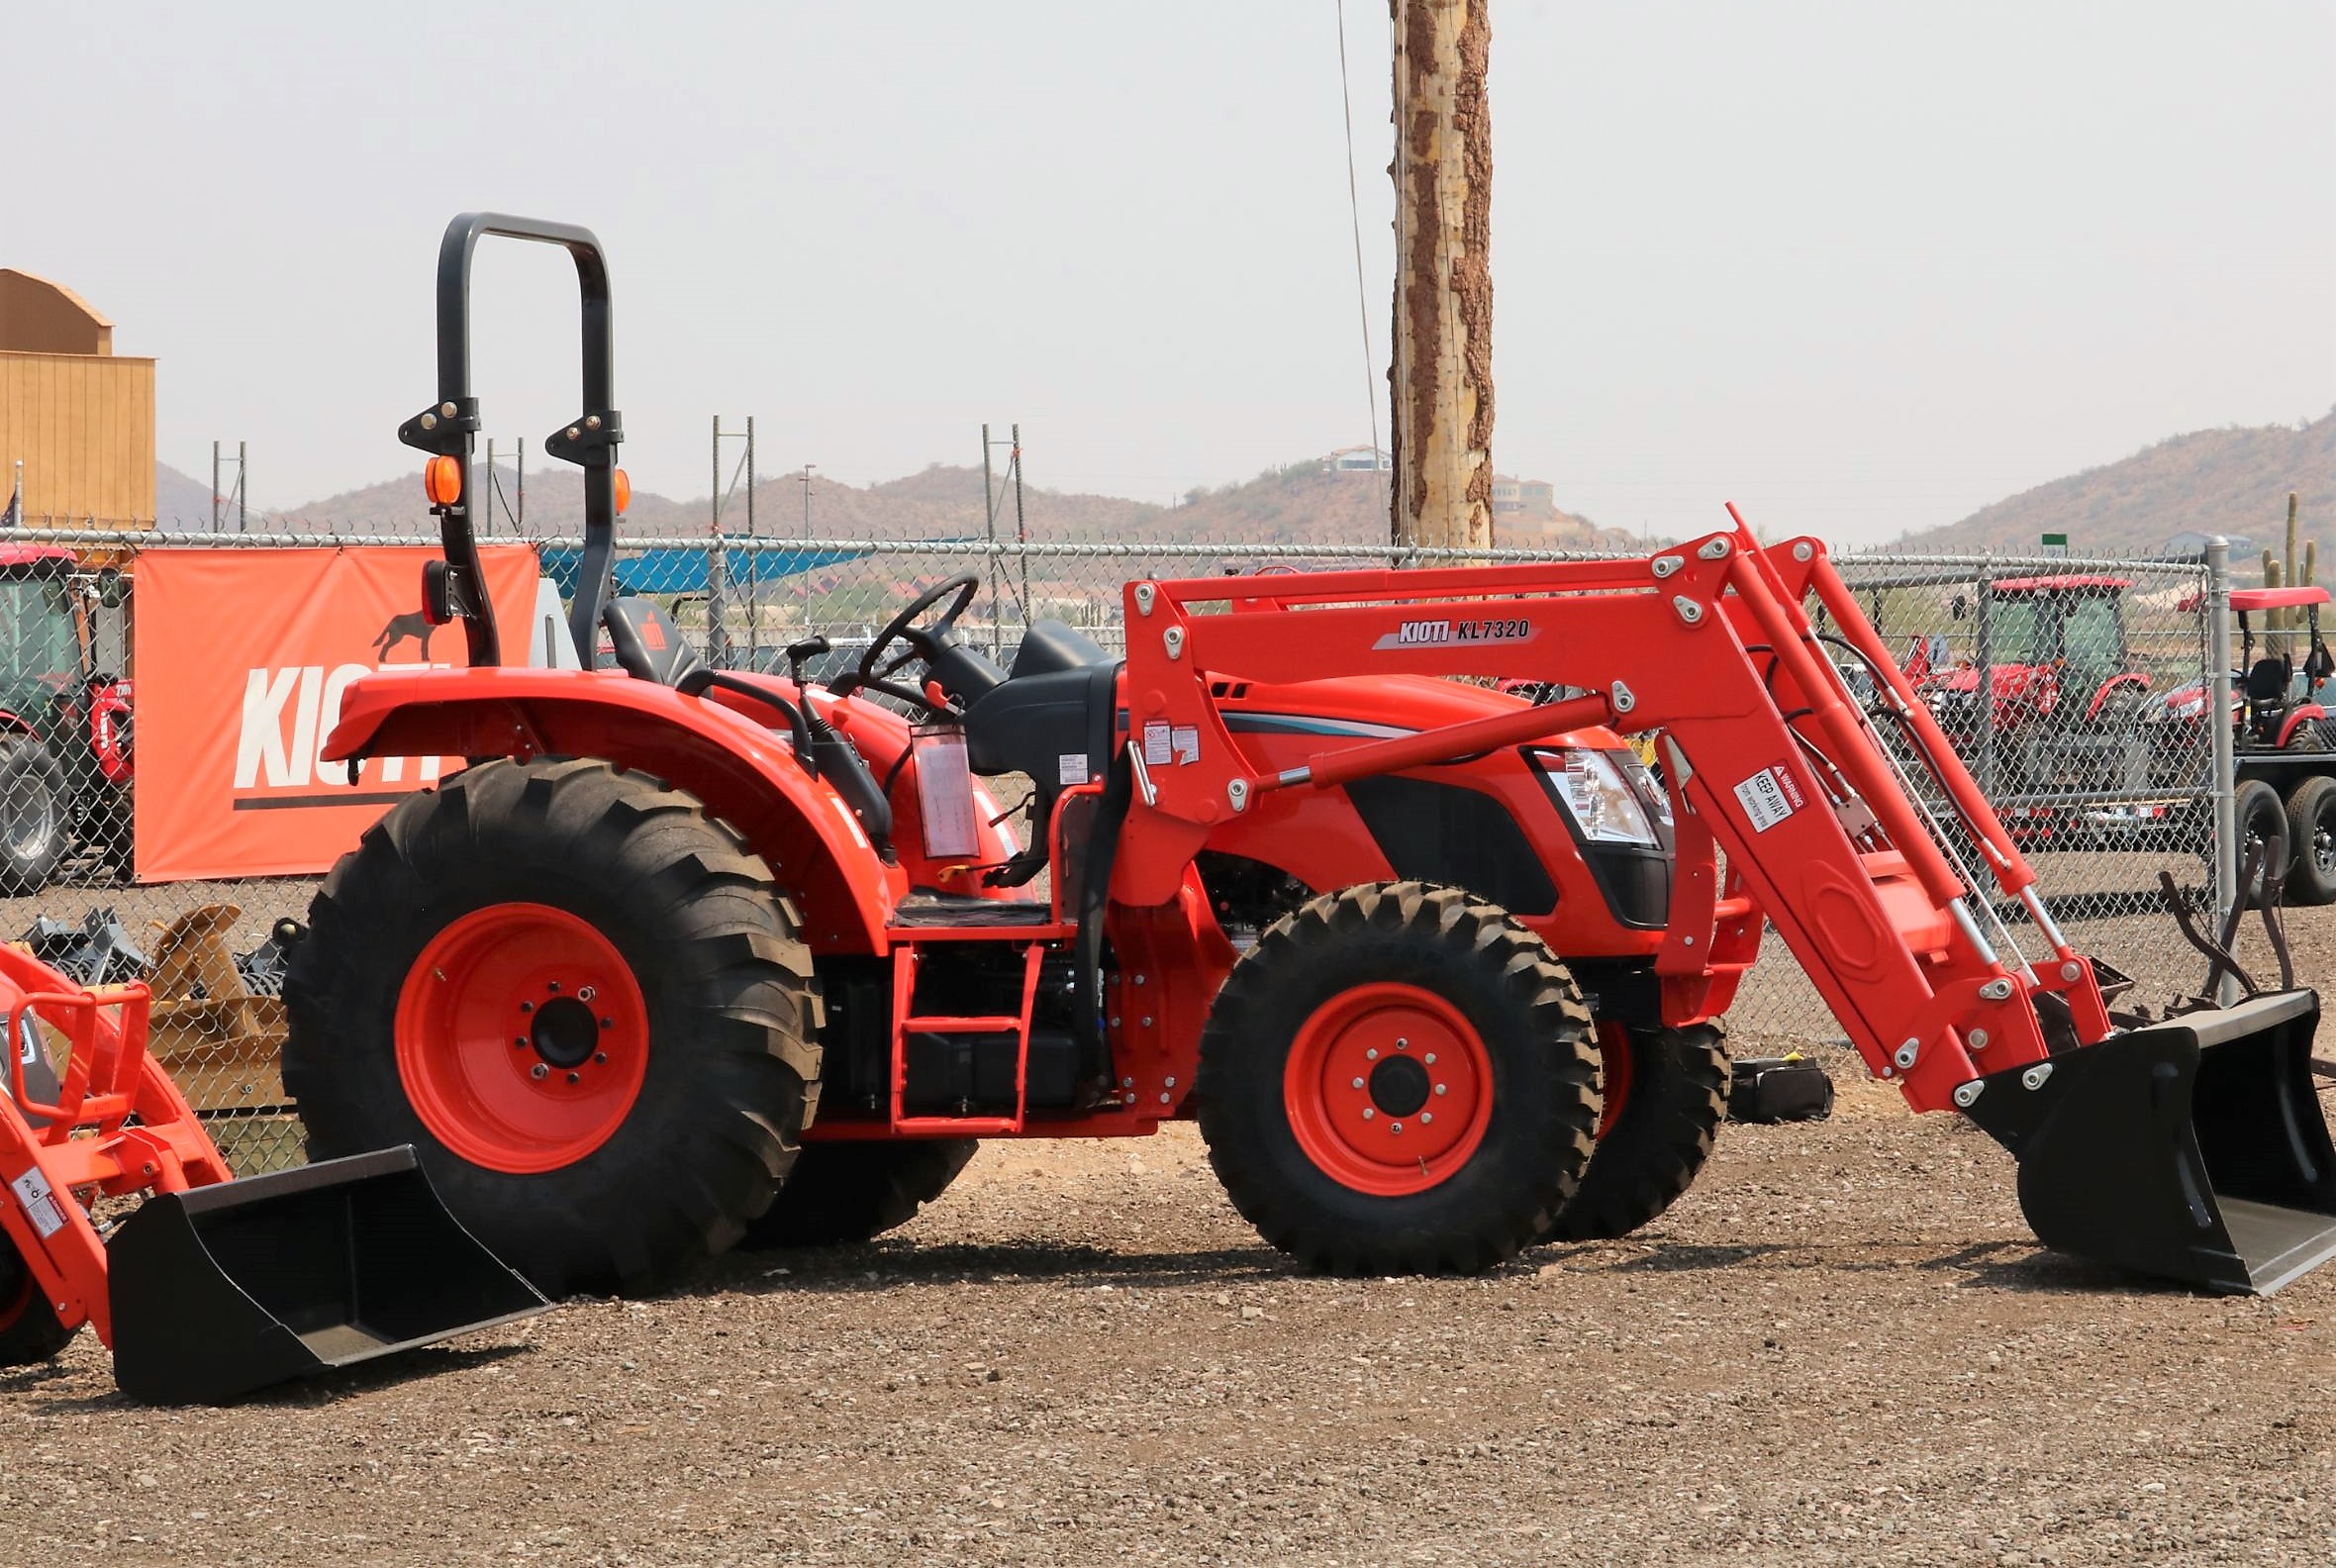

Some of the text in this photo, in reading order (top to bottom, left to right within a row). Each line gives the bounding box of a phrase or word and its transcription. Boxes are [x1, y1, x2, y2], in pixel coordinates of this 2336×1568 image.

[1399, 619, 1529, 643] KIOTI KL7320
[233, 663, 451, 788] KIO
[1754, 774, 1788, 818] KEEP AWAY
[1780, 773, 1803, 808] WARNING
